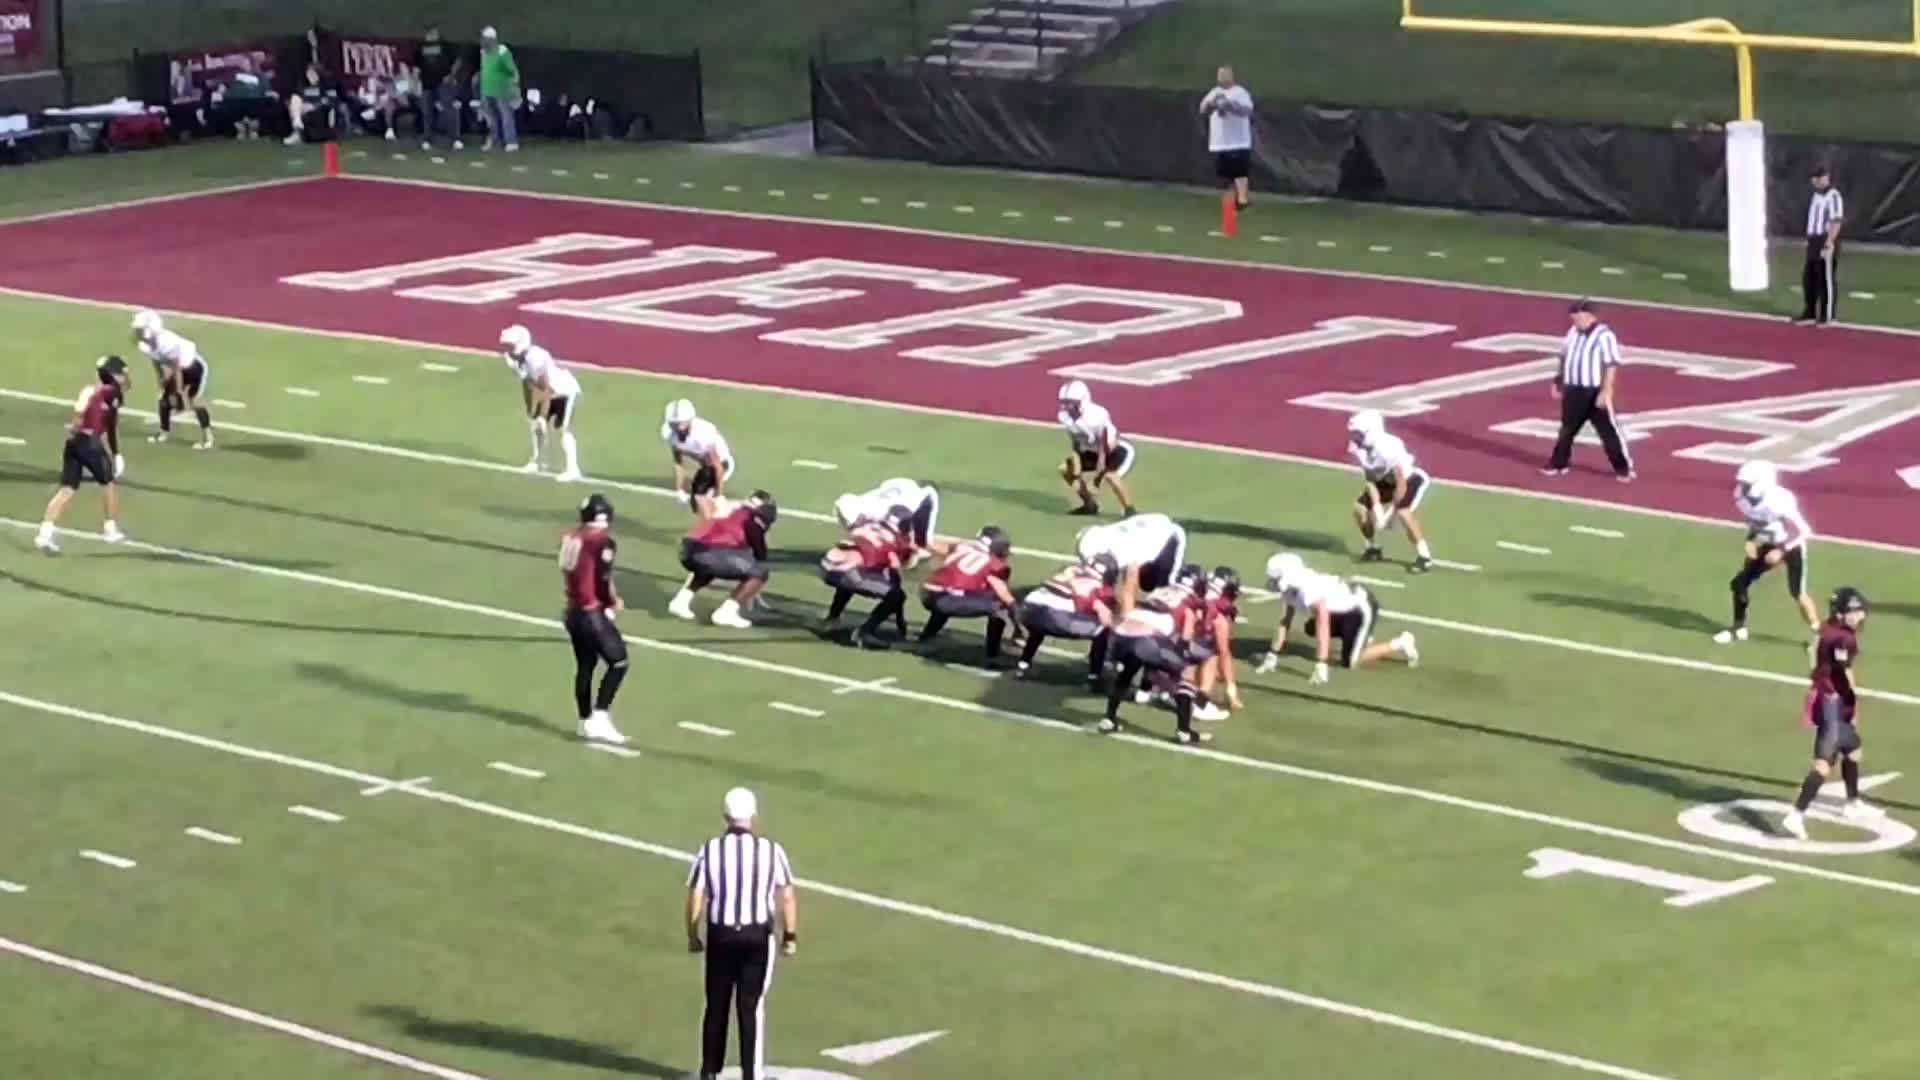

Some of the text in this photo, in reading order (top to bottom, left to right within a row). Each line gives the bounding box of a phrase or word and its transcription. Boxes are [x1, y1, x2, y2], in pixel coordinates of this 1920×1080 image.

[276, 232, 1920, 490] HERITA
[943, 544, 990, 576] 70
[1522, 799, 1917, 908] 10
